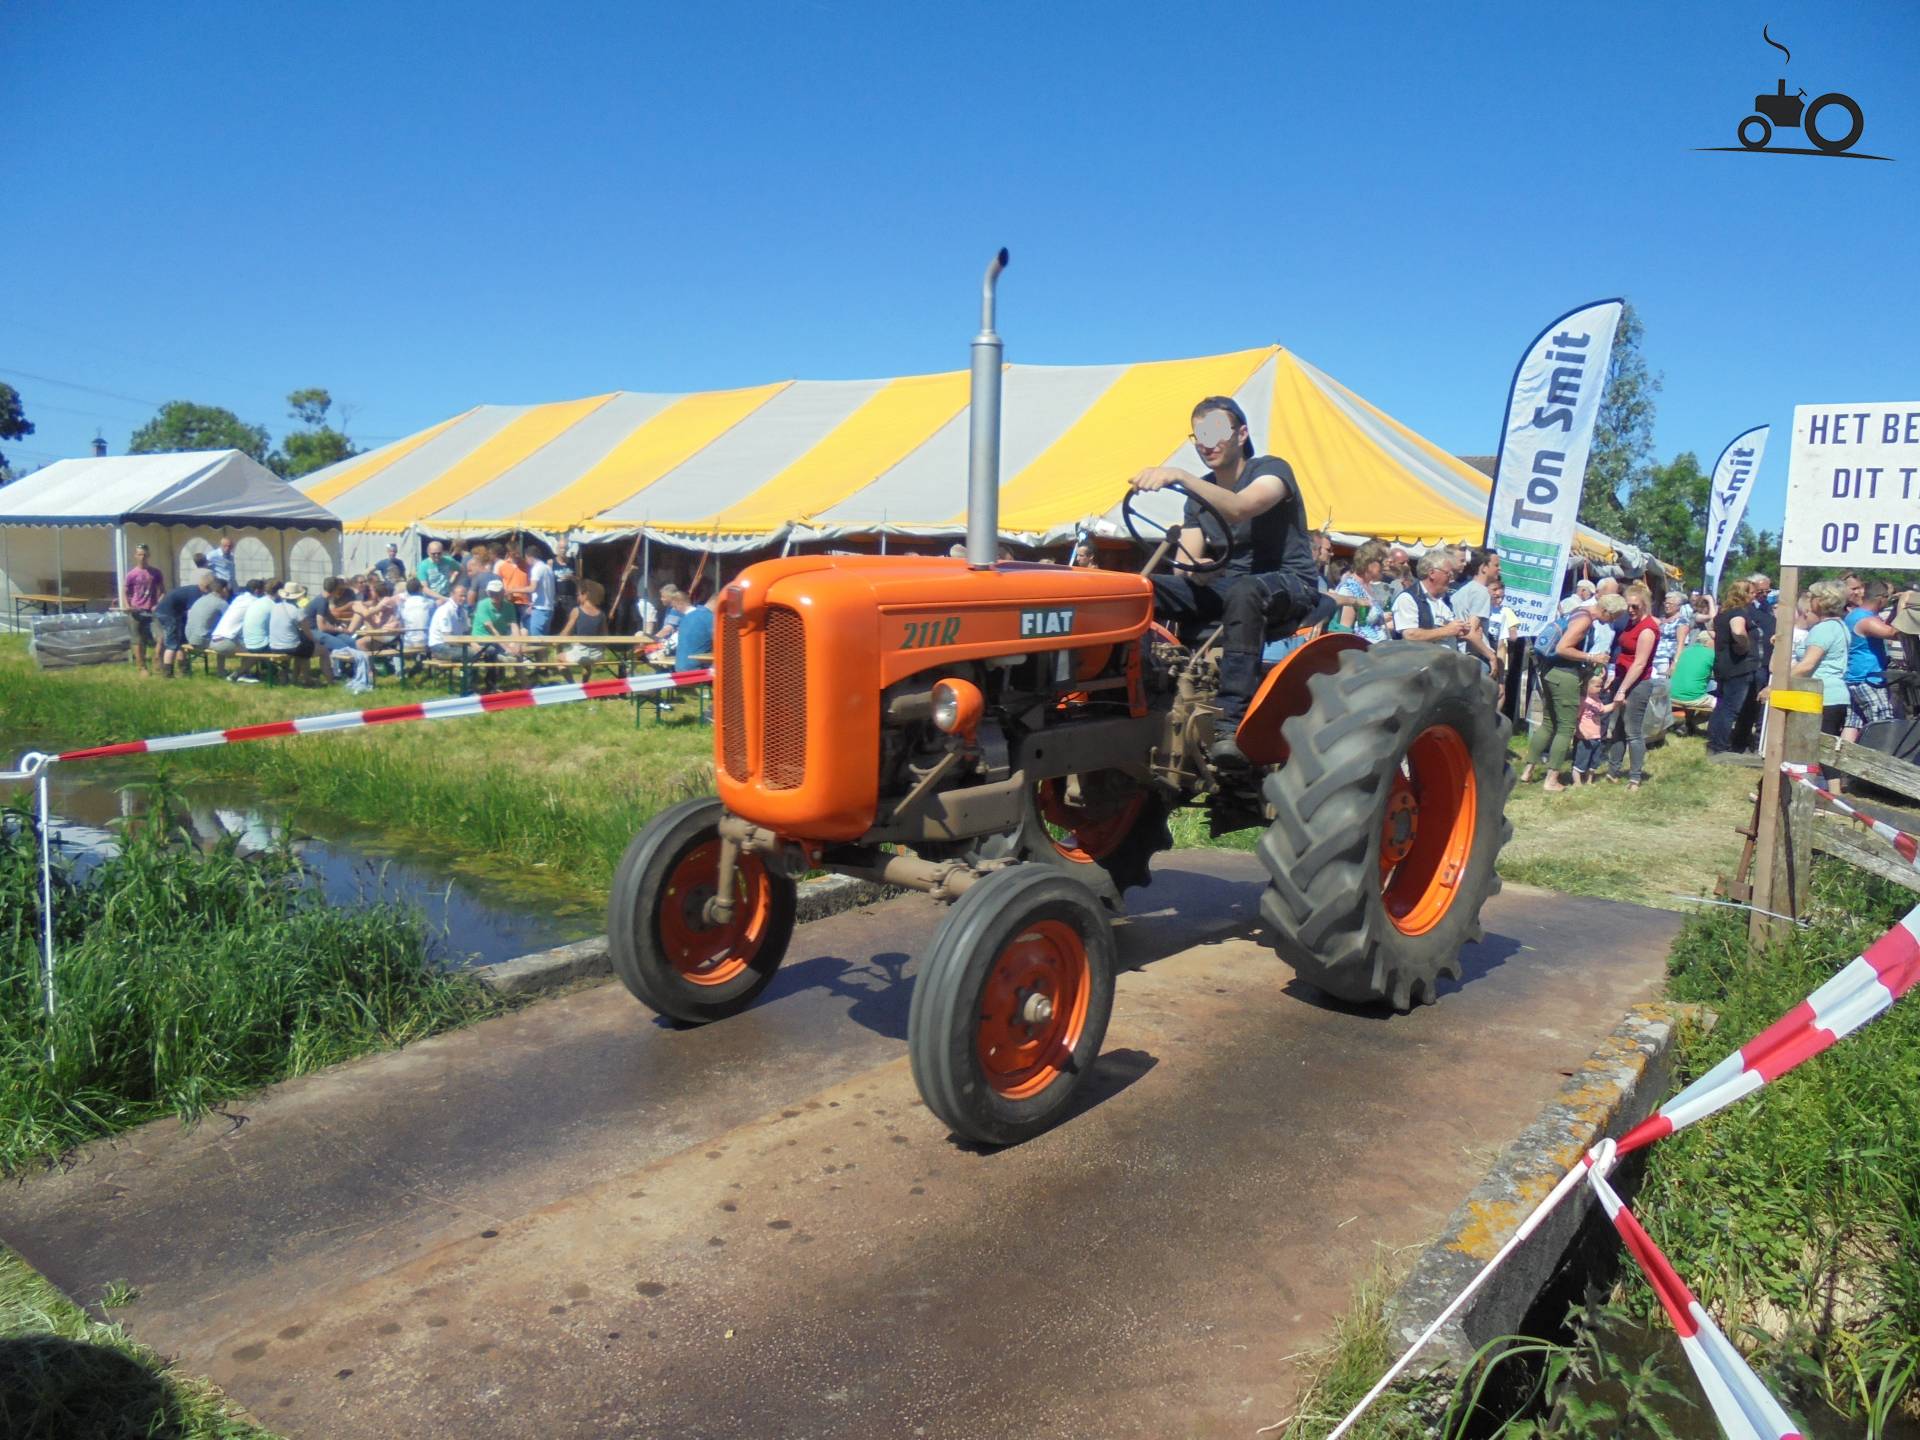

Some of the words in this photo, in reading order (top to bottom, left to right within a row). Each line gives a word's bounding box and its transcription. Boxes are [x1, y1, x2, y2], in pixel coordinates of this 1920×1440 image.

[1532, 330, 1592, 433] Smit
[1808, 413, 1871, 445] HET
[1881, 412, 1920, 444] BE
[1511, 449, 1566, 529] Ton
[1720, 447, 1755, 507] Smit
[1831, 467, 1884, 499] DIT
[1899, 467, 1920, 500] T
[1820, 522, 1859, 553] OP
[1871, 523, 1920, 555] EIG
[1513, 608, 1548, 622] deuren
[1530, 600, 1542, 608] en
[900, 616, 961, 649] 211R
[1021, 611, 1073, 635] FIAT
